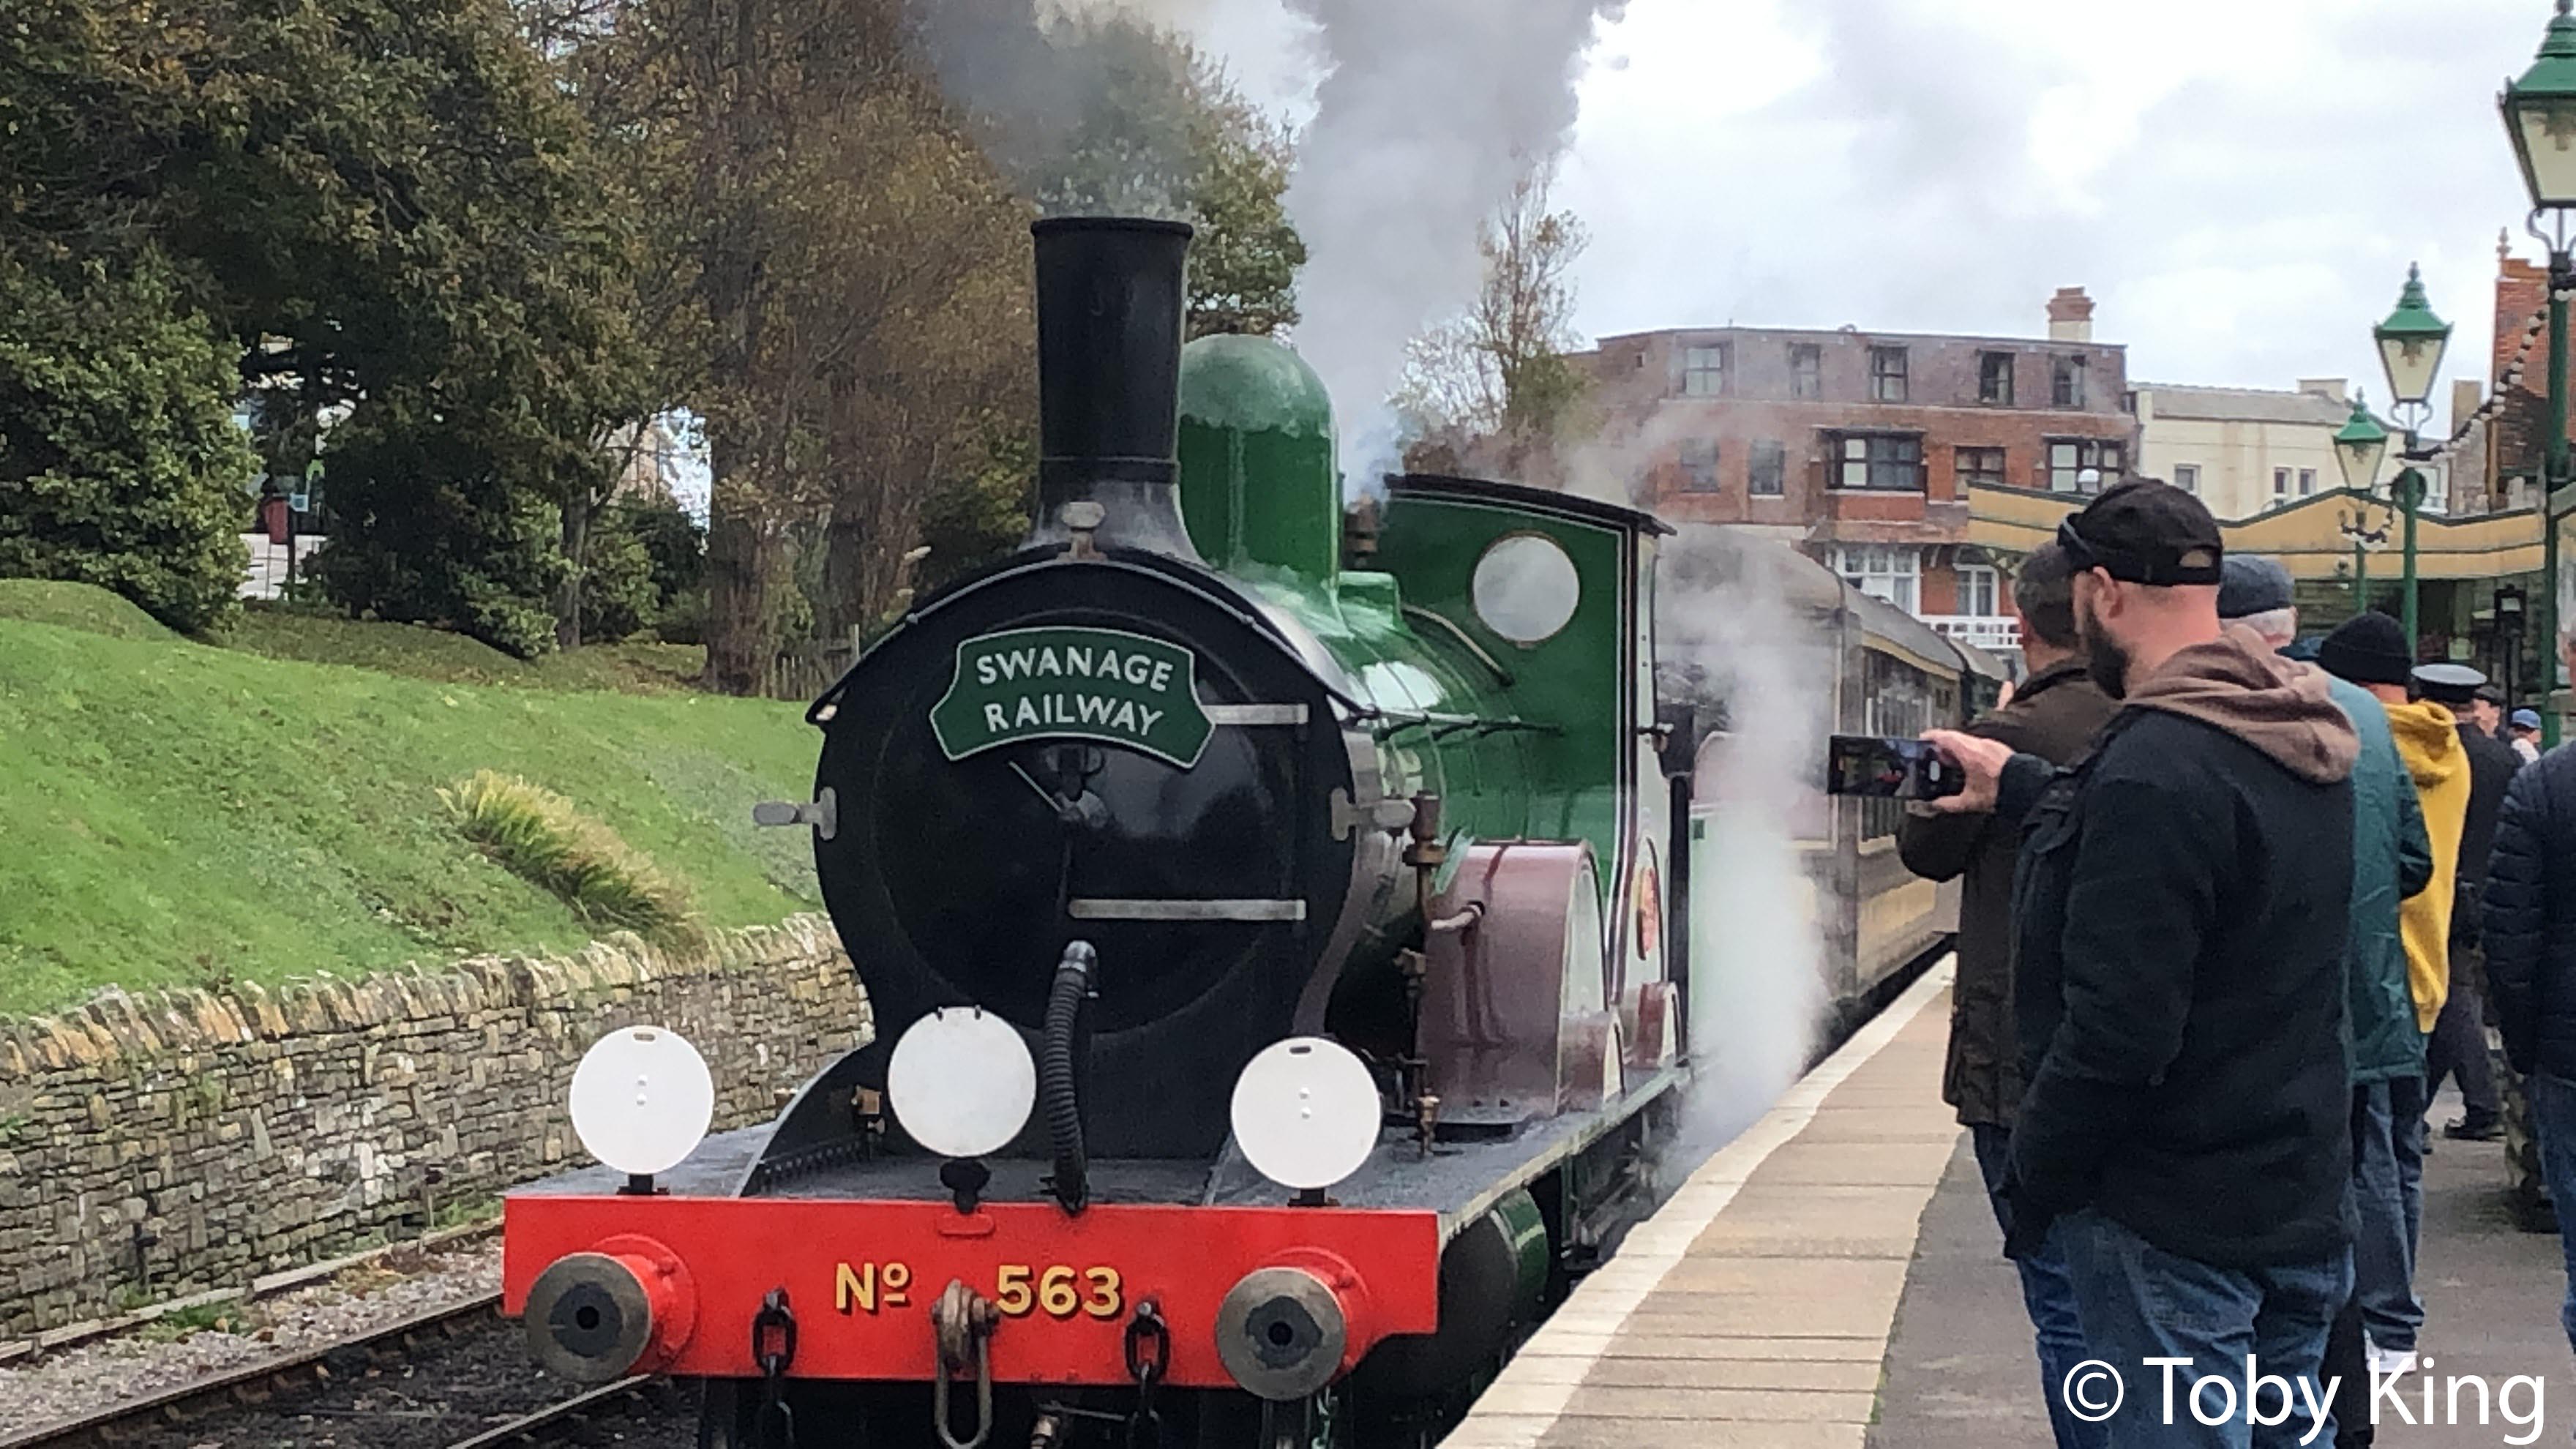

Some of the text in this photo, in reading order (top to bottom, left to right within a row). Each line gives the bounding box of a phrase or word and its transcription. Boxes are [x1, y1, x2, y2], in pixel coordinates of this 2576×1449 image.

[976, 646, 1174, 692] SWANAGE
[984, 693, 1164, 736] RAILWAY
[996, 1265, 1121, 1317] 563
